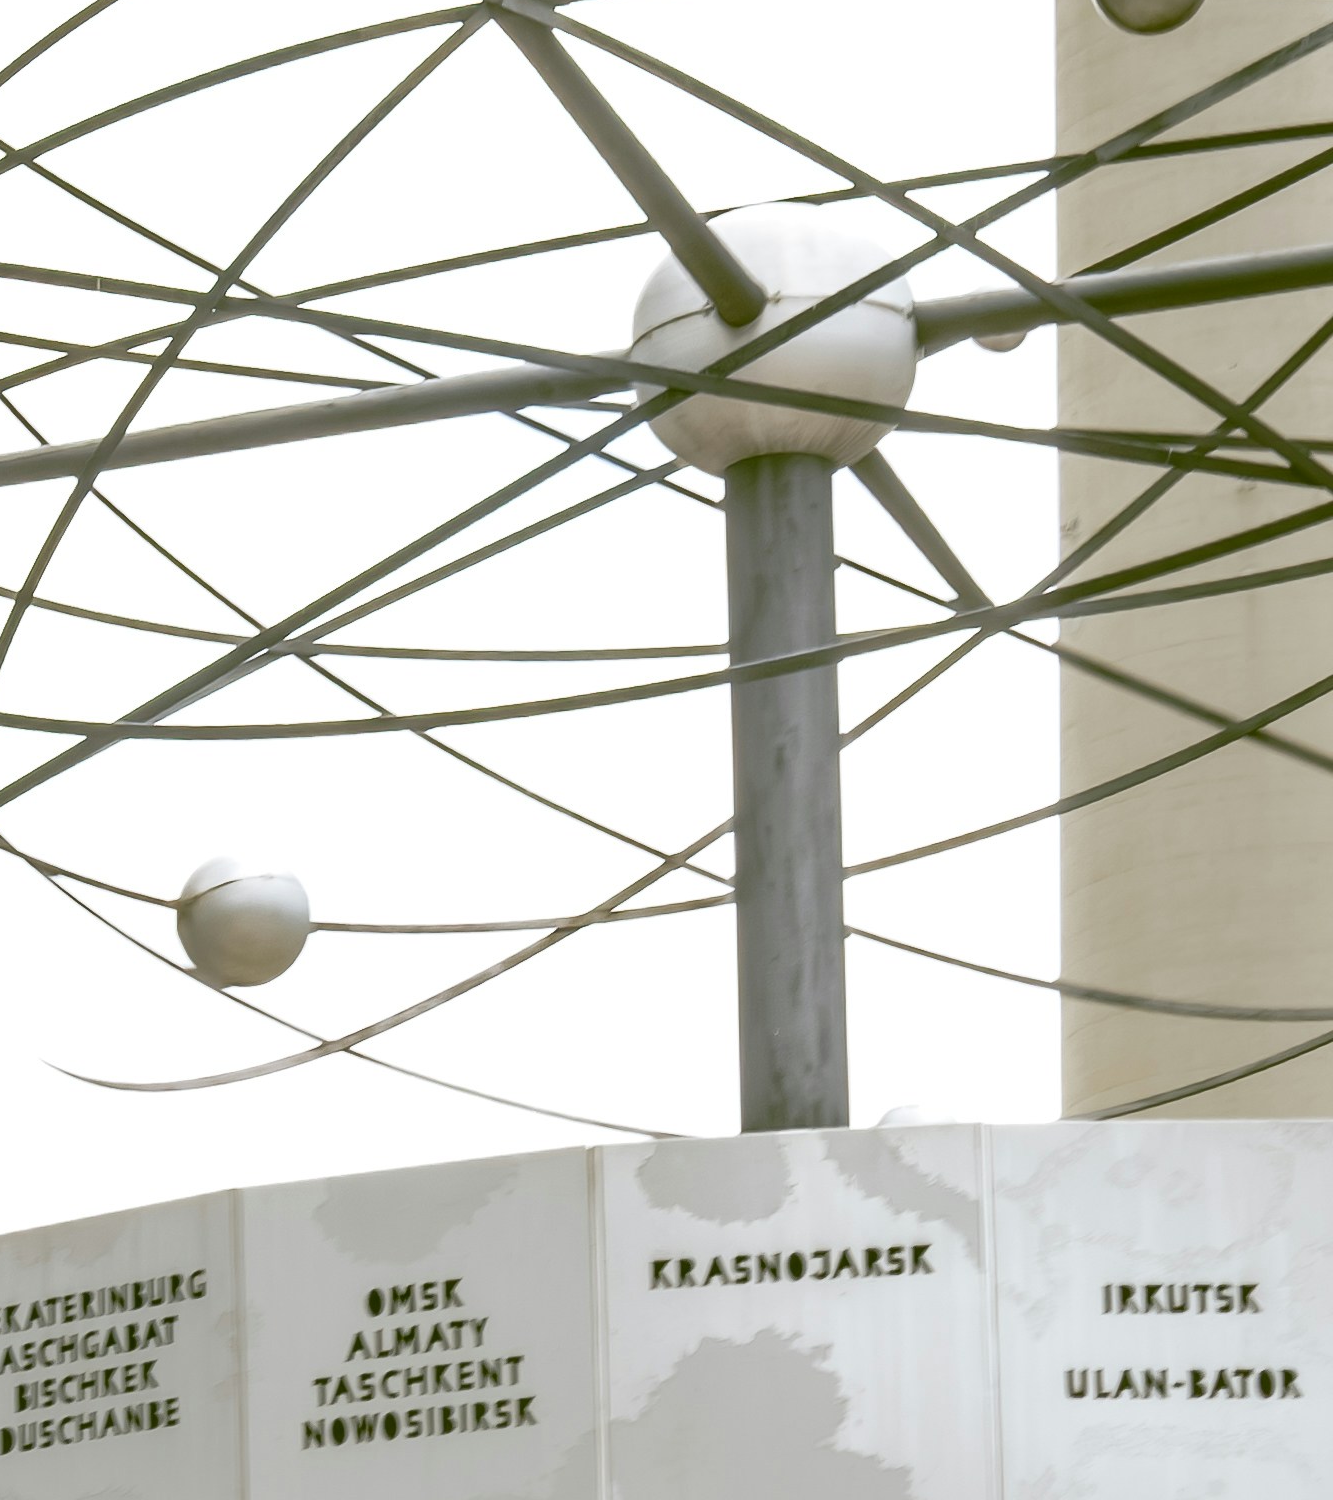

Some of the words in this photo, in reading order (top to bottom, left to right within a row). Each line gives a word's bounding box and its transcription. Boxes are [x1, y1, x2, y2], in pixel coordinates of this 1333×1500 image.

[649, 1243, 934, 1291] KRASNOJARSK
[365, 1278, 464, 1318] OMSK
[1101, 1283, 1263, 1315] IRKUTSK
[347, 1317, 487, 1363] ALMATY
[14, 1359, 159, 1414] BISCHKEK
[313, 1356, 524, 1408] TASCHKENT
[1064, 1367, 1303, 1401] ULAN-BATOR
[301, 1396, 537, 1450] NOWOSIBIRSK
